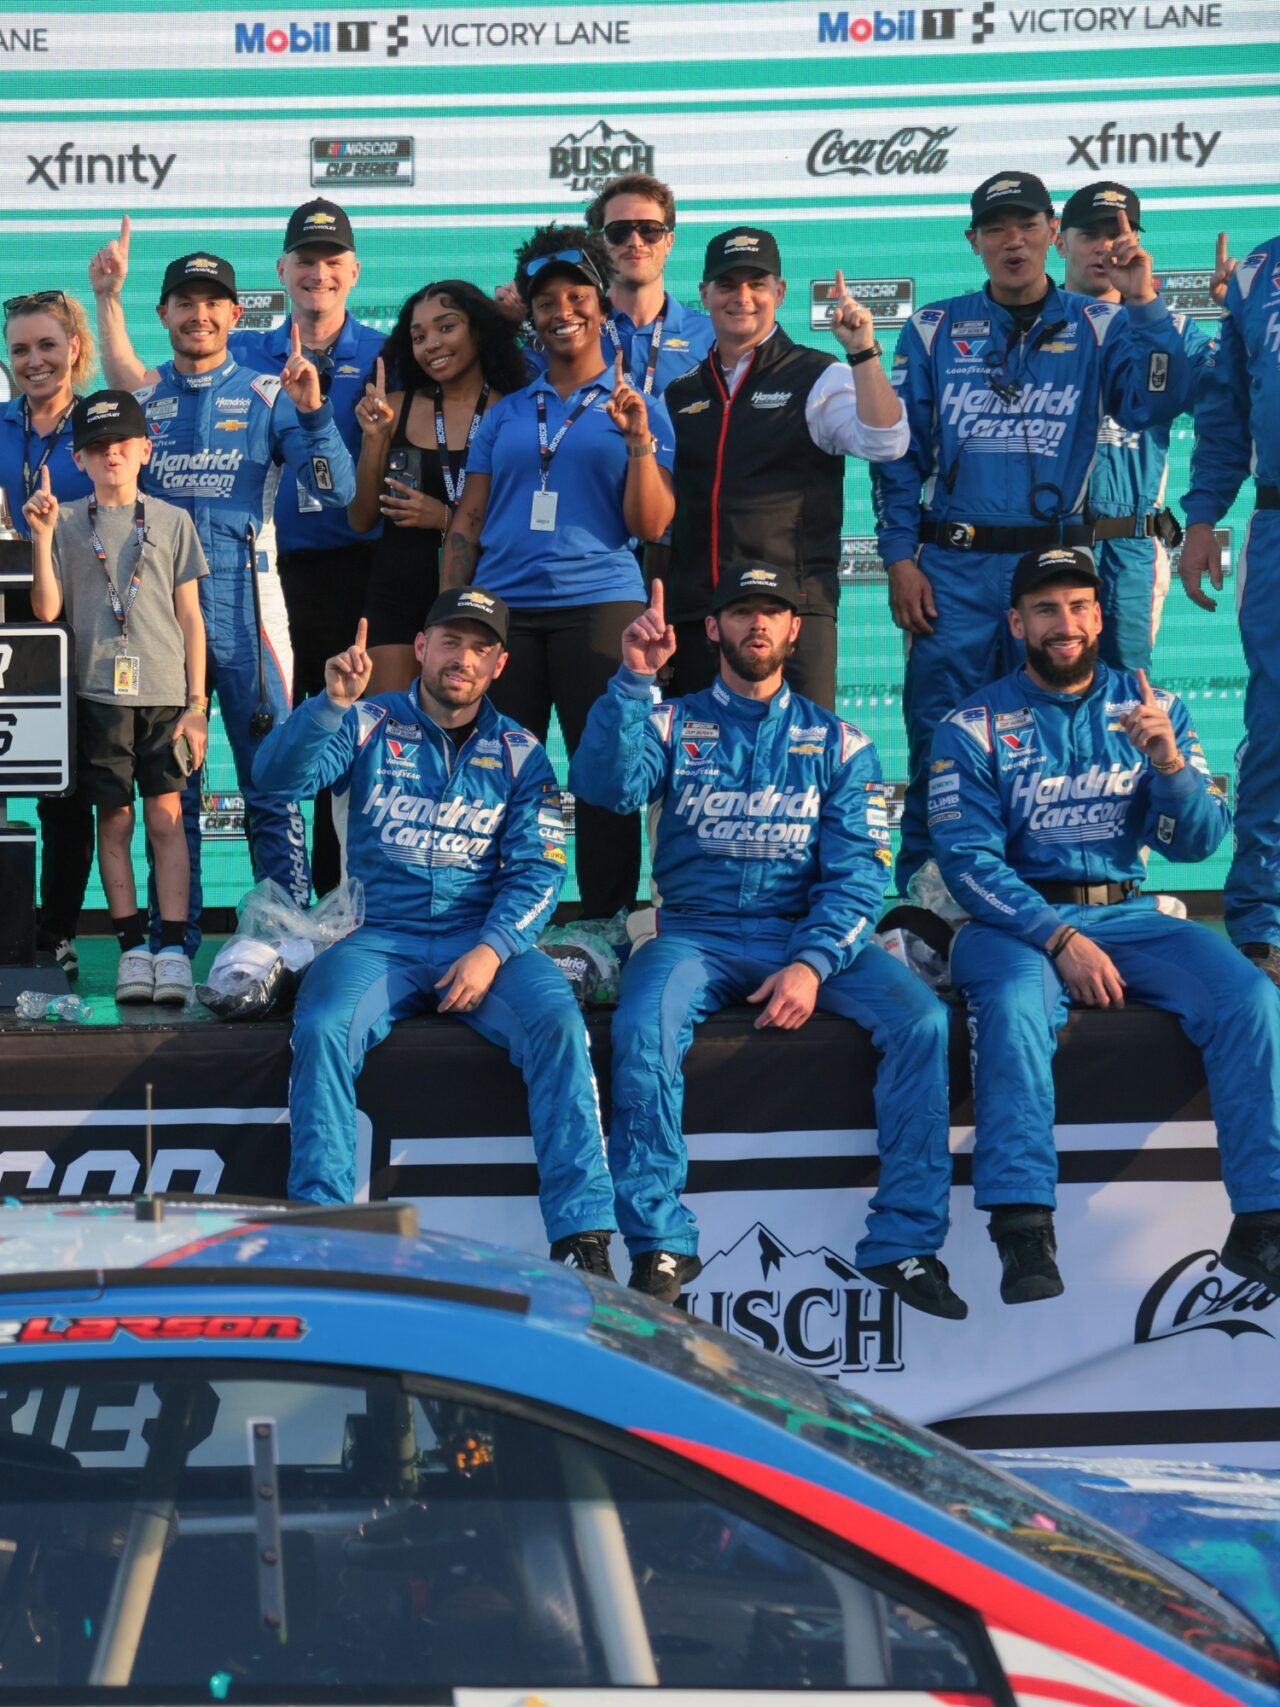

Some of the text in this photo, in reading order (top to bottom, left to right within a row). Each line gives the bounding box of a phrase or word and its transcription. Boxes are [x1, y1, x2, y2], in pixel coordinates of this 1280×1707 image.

[235, 22, 330, 54] Mobil
[422, 22, 547, 47] VICTORY
[555, 20, 631, 45] LANE
[818, 11, 915, 43] Mobil
[1008, 6, 1137, 33] VICTORY
[1144, 3, 1222, 30] LANE
[344, 141, 399, 156] NASCAR
[806, 126, 958, 177] Coca-Cola
[1066, 121, 1222, 172] xfinity
[27, 142, 177, 190] xfinity
[325, 161, 399, 177] CUP SERIES
[549, 144, 655, 180] BUSCH
[215, 397, 252, 409] Hendrick
[750, 391, 793, 404] Hendrick
[939, 382, 1080, 425] Hendrick
[957, 416, 1067, 440] Cars.com
[149, 448, 244, 481] Hendrick
[162, 472, 235, 490] Cars.com
[951, 529, 965, 542] 5
[739, 580, 779, 588] CHEVROLET
[457, 600, 494, 614] CHEVROLET
[376, 768, 421, 781] GOODYEAR
[362, 783, 506, 834] Hendrick
[674, 783, 821, 827] Hendrick
[927, 794, 960, 811] CLIMB
[1029, 800, 1131, 831] Cars.com
[380, 820, 493, 856] Cars.com
[696, 816, 812, 843] Cars.com
[20, 1314, 308, 1343] LARSON
